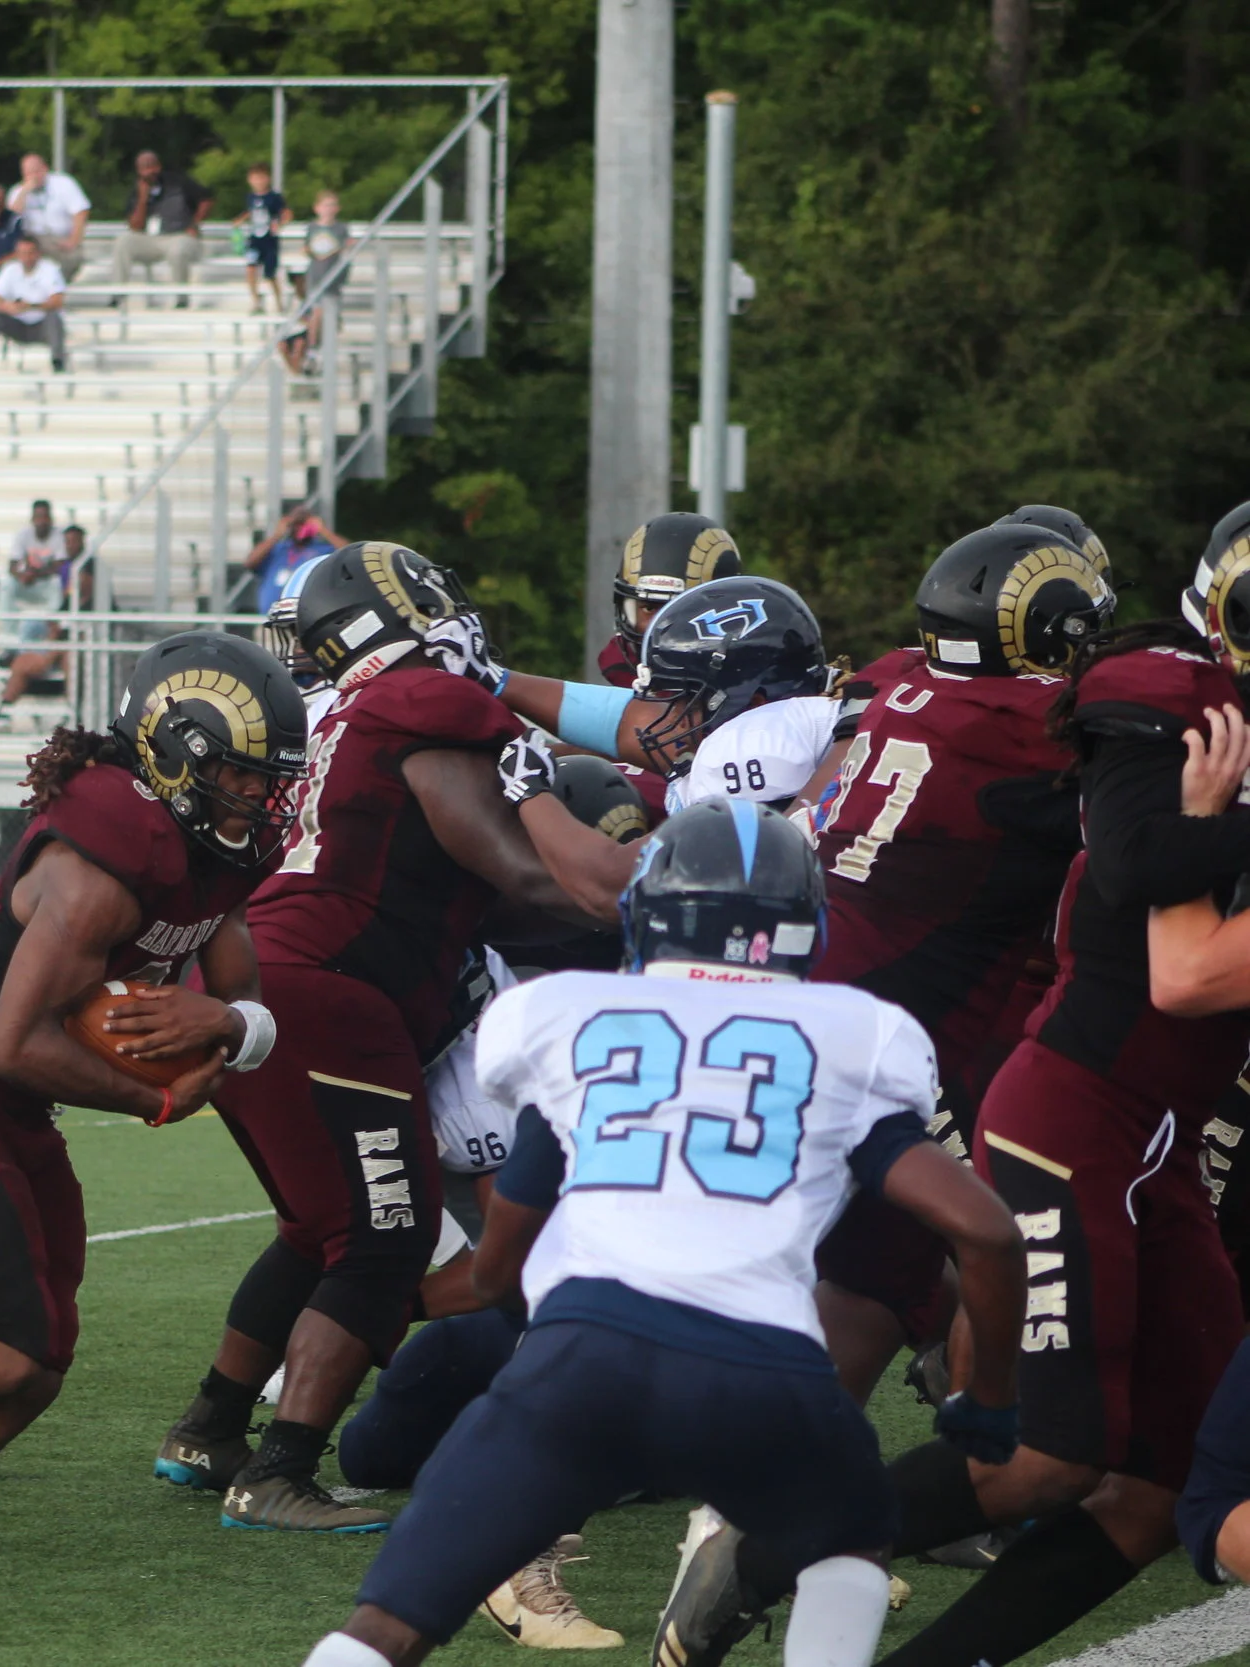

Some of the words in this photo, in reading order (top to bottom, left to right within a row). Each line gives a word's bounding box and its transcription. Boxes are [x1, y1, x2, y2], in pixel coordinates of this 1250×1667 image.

[315, 638, 346, 668] 71
[279, 750, 306, 762] Riddell
[723, 758, 766, 795] 98
[558, 1009, 818, 1206] 23
[466, 1131, 508, 1167] 96
[354, 1127, 416, 1230] RAMS
[1014, 1208, 1071, 1353] RAMS
[177, 1446, 211, 1470] UA
